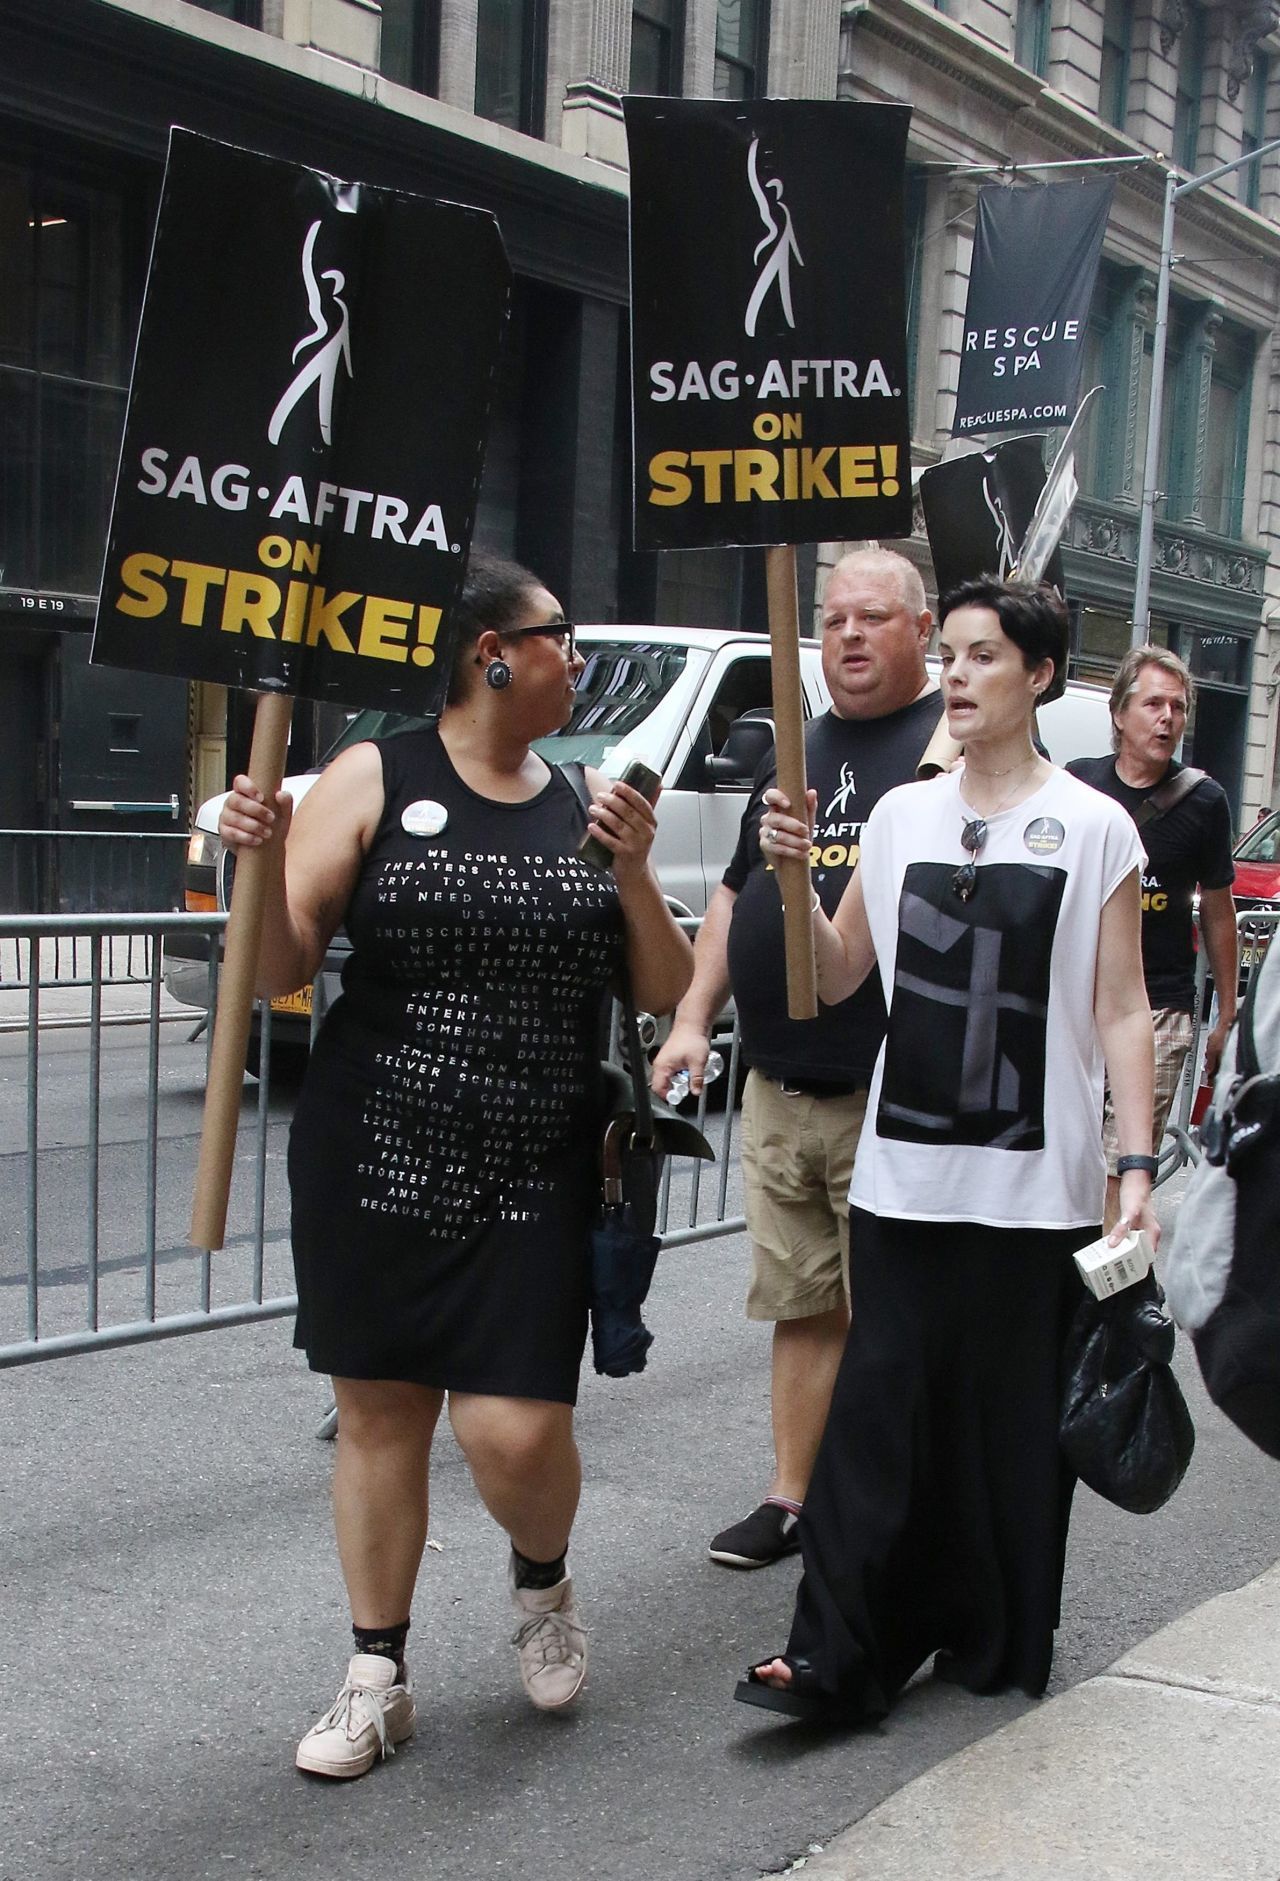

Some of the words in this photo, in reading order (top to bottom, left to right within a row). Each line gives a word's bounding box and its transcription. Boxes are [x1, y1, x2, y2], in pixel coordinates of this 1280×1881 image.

[966, 320, 1079, 351] RESCUE
[993, 350, 1041, 376] SPA
[960, 405, 1067, 428] RESCUESPA.COM
[753, 413, 803, 441] ON
[648, 445, 900, 506] STRIKE!
[258, 535, 321, 574] ON
[21, 597, 35, 608] 19
[38, 599, 47, 609] E
[50, 600, 64, 611] 19
[116, 552, 443, 668] STRIKE!
[427, 849, 449, 859] WE
[464, 853, 508, 864] COME
[523, 855, 544, 864] TO
[384, 861, 479, 876] THEATERS
[496, 867, 517, 877] TO
[533, 868, 598, 878] LAUGH.
[377, 876, 421, 886] CRY,
[443, 877, 466, 887] TO
[378, 892, 398, 903] WE
[418, 891, 472, 903] NEED
[572, 897, 608, 907] ALL
[520, 911, 569, 923] THAT
[410, 944, 435, 956] WE
[454, 943, 491, 953] GET
[508, 943, 560, 955] WHEN
[375, 1053, 441, 1078] SILVER
[374, 1132, 414, 1150] FEEL
[358, 1163, 428, 1186] STORIES
[387, 1186, 419, 1200] AND
